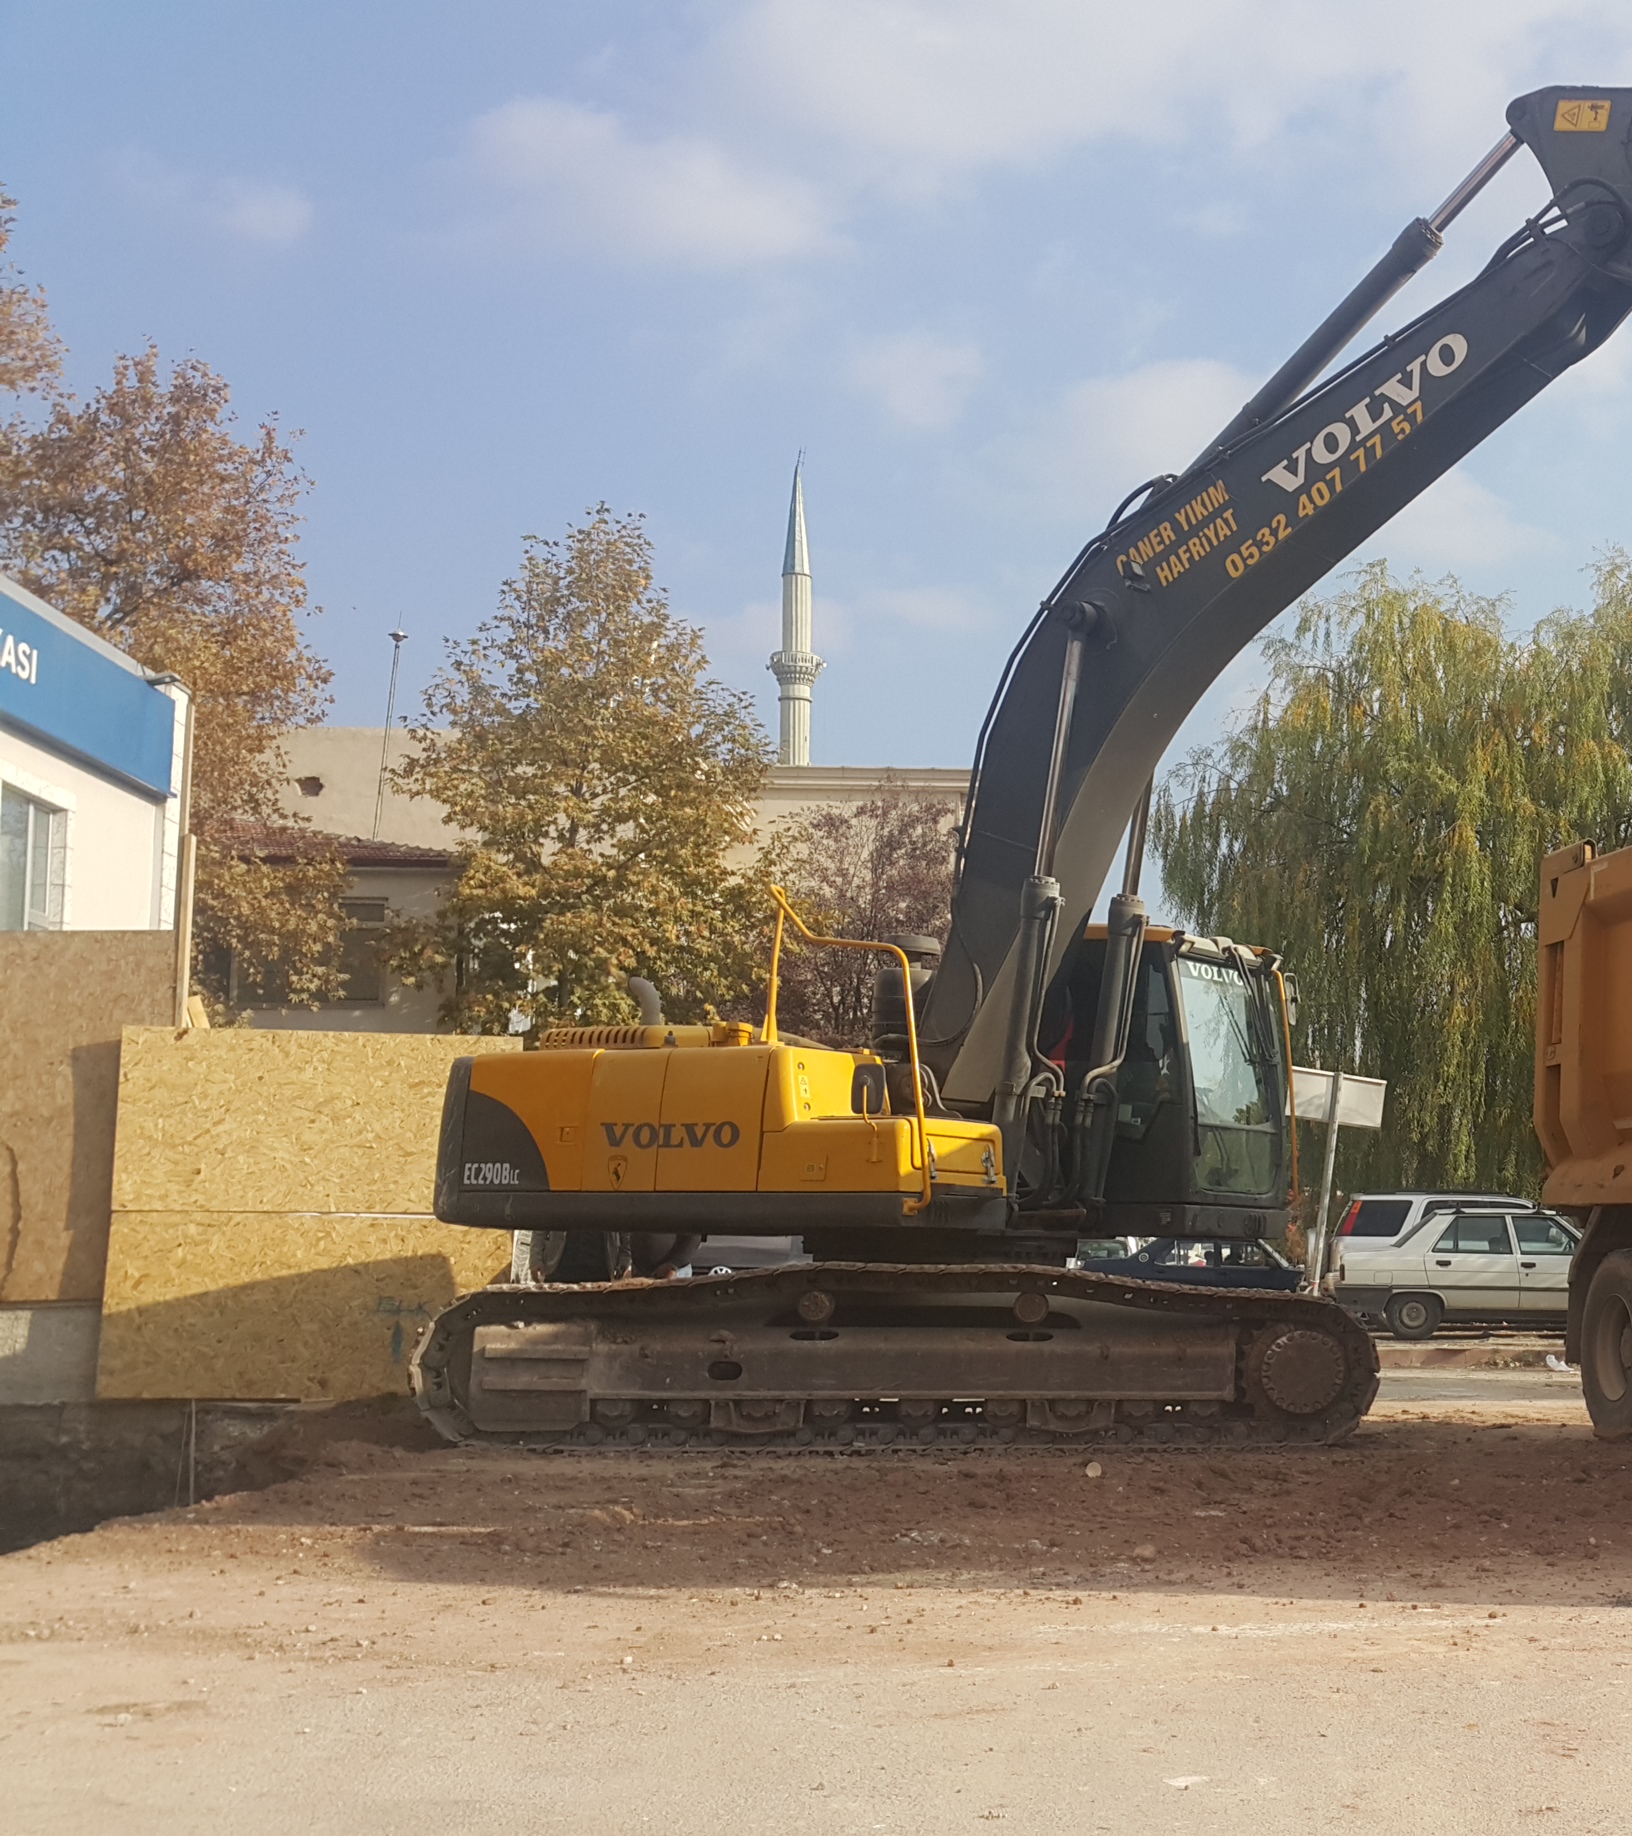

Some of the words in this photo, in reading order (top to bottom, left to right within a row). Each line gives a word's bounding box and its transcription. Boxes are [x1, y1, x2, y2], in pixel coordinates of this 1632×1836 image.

[1261, 333, 1469, 492] VOLVO
[1174, 479, 1230, 532] YIKIM
[1225, 513, 1292, 579] 0532
[1298, 466, 1343, 518] 407
[1350, 434, 1383, 473] 77
[1391, 400, 1424, 440] 57
[0, 628, 38, 685] ASI
[601, 1120, 741, 1149] VOLVO
